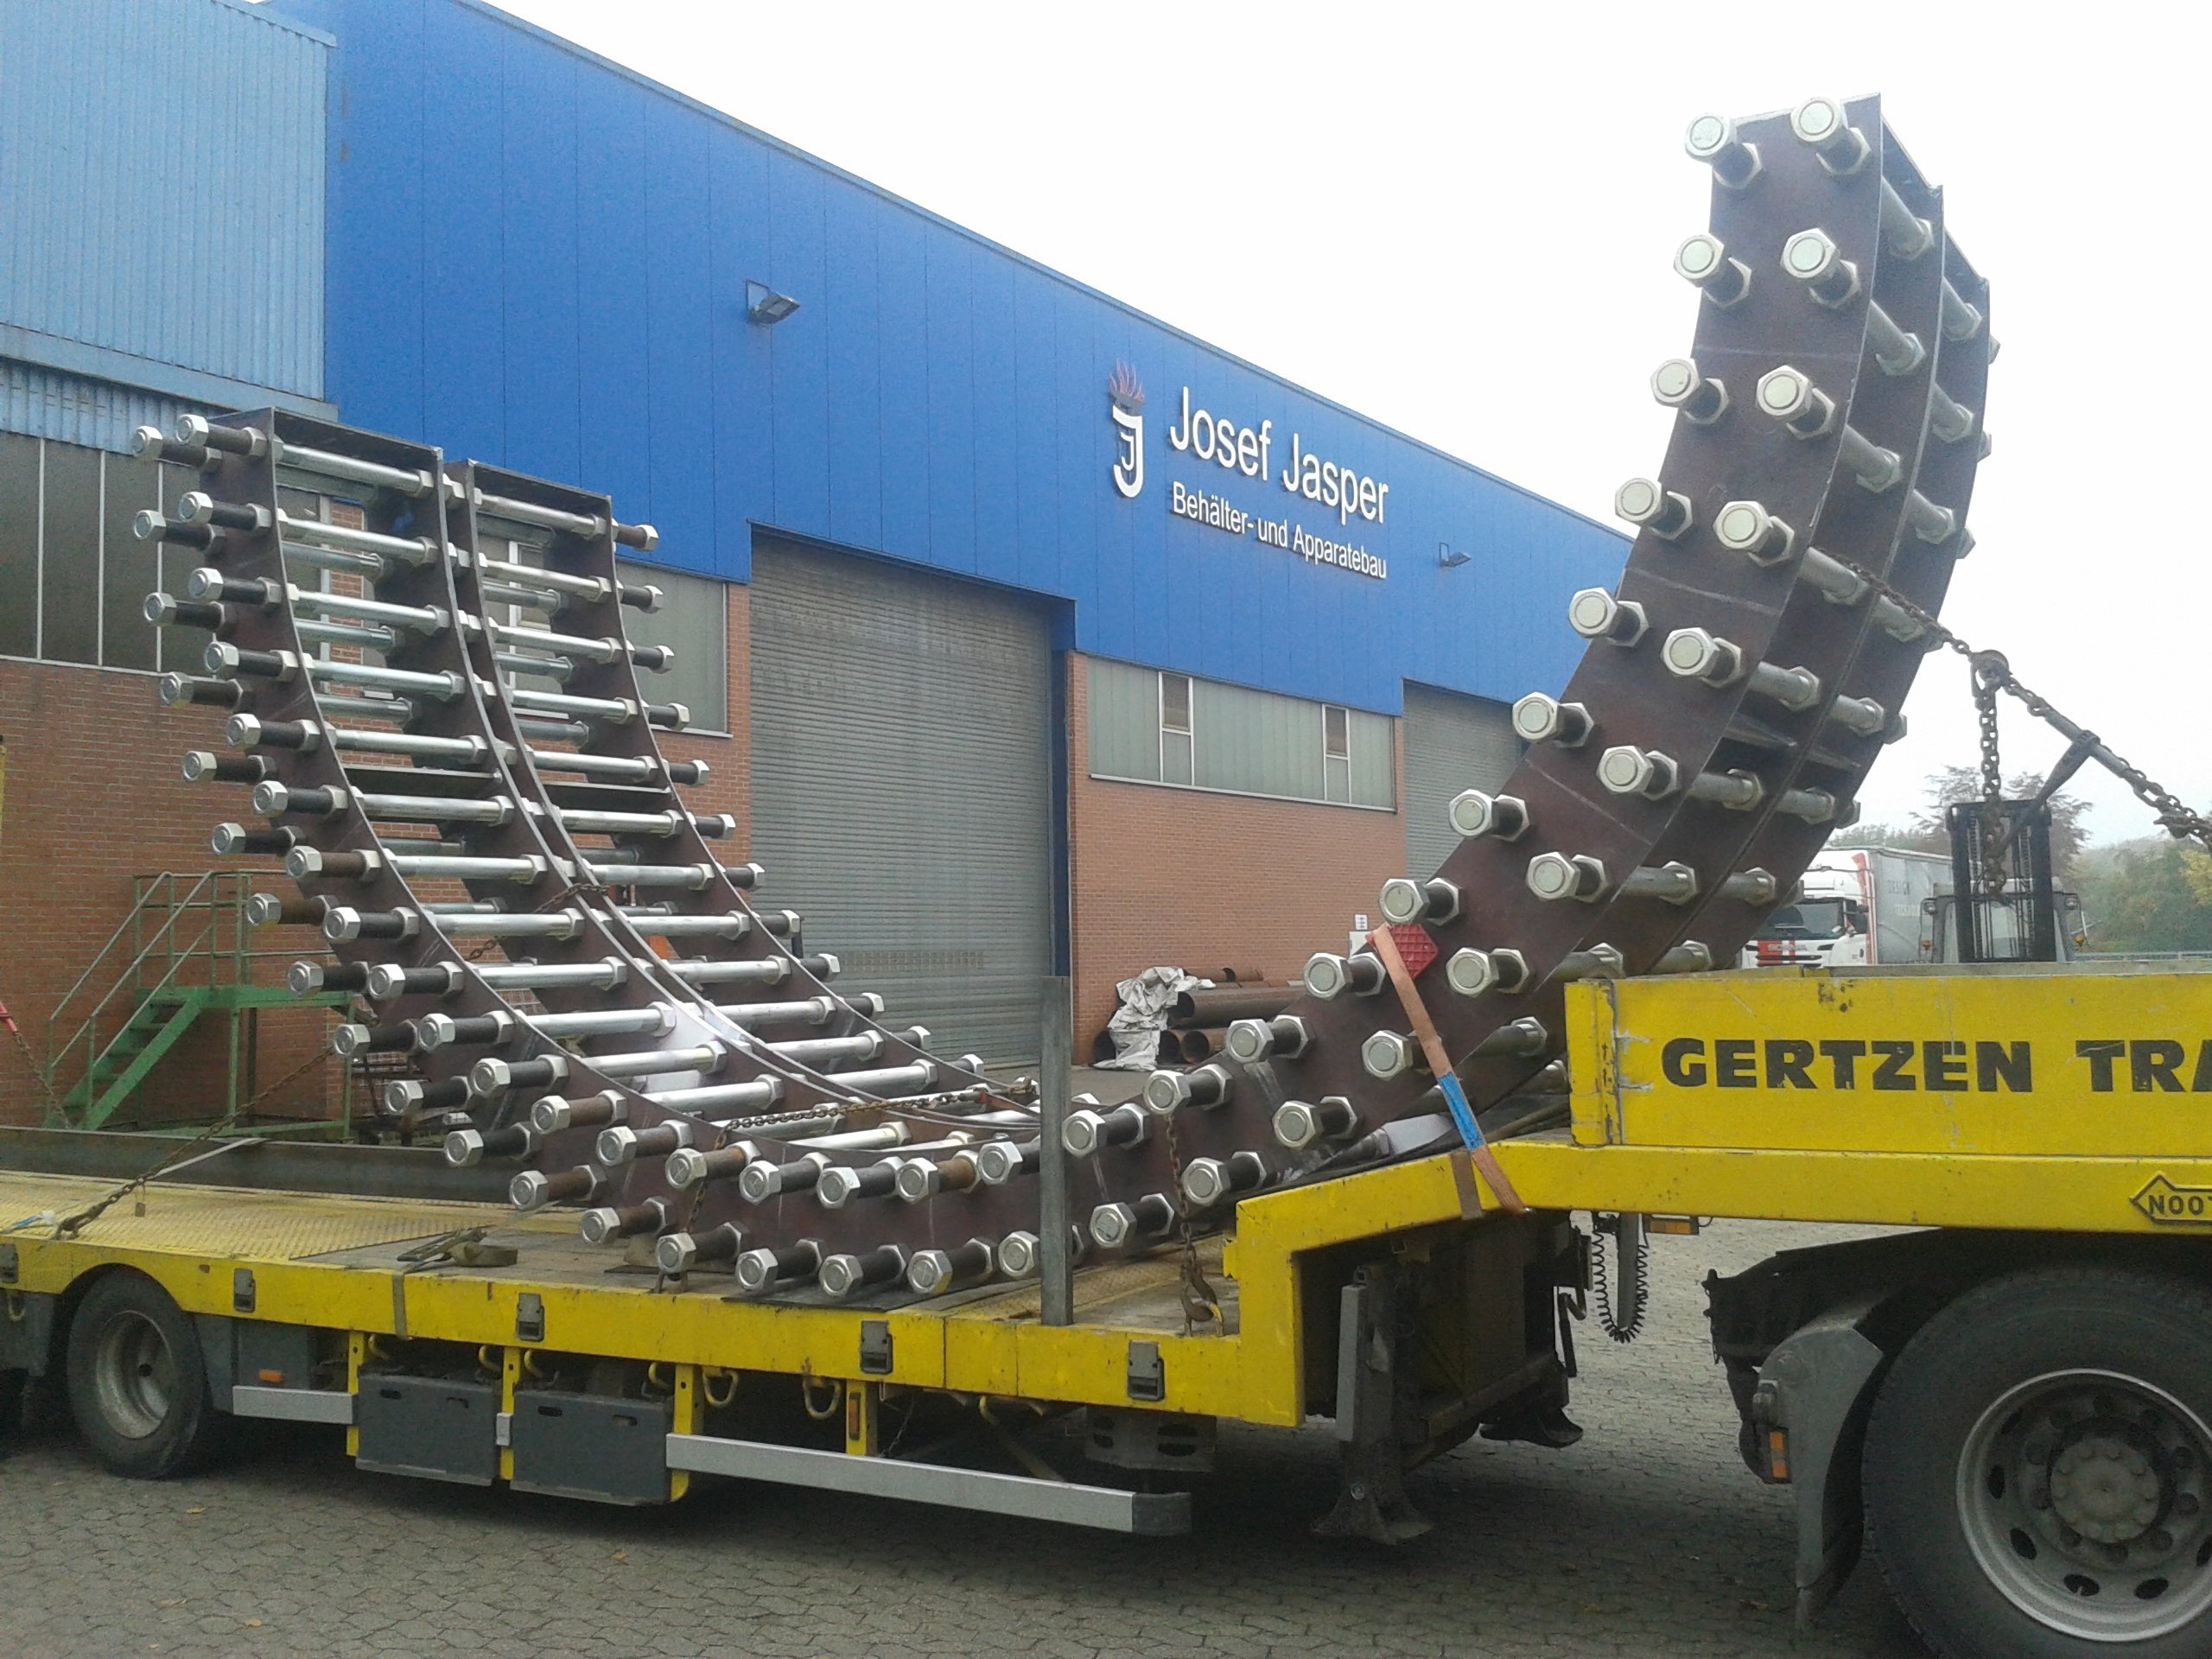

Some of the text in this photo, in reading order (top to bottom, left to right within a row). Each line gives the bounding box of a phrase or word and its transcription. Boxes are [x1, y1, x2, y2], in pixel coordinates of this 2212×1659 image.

[1170, 386, 1389, 525] Josef Jasper
[1173, 480, 1387, 579] Behälter- und Apparatebau
[1661, 1037, 2033, 1093] GERTZEN
[2148, 1194, 2212, 1216] NOO
